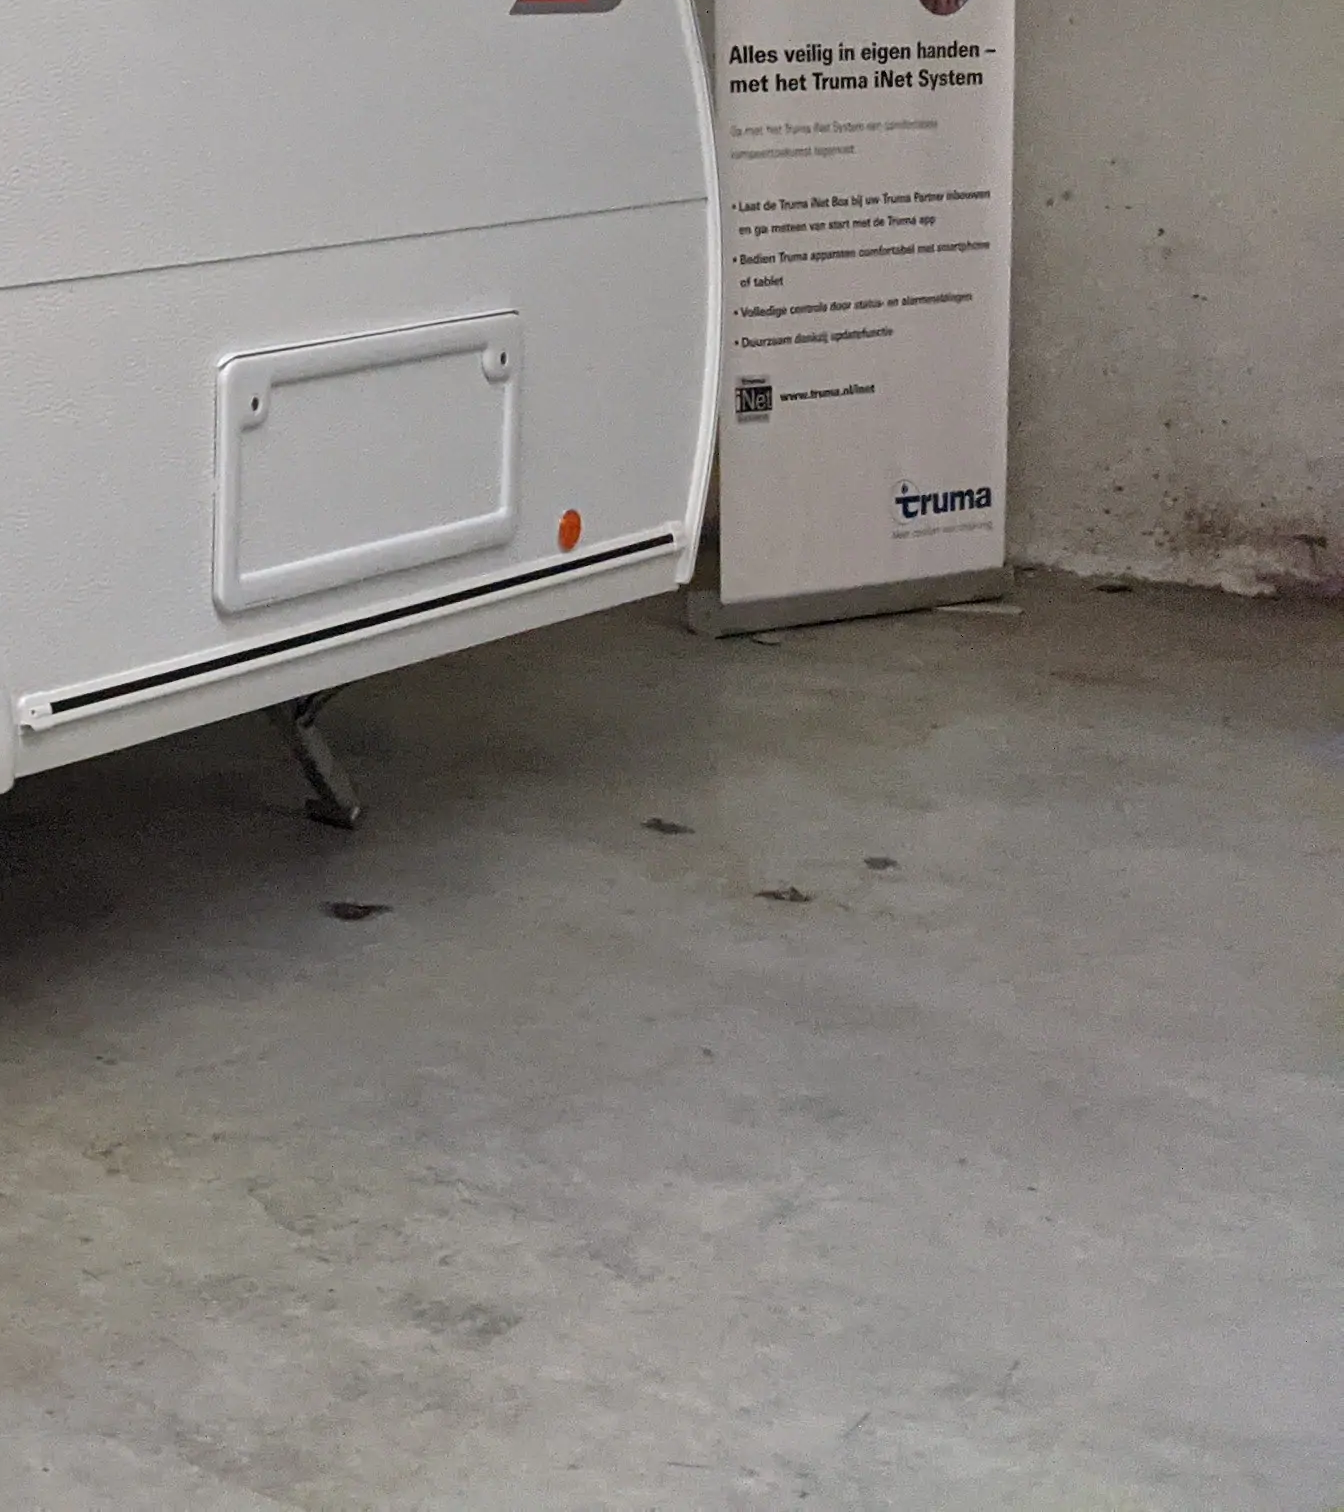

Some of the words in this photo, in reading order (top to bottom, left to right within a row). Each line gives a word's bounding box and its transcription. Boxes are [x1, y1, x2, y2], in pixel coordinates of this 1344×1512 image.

[729, 45, 778, 65] Alles
[784, 43, 833, 66] veilig
[838, 42, 855, 62] in
[860, 42, 911, 64] eigen
[916, 40, 980, 59] handen
[729, 75, 769, 93] met
[775, 73, 807, 92] het
[812, 72, 868, 90] Truma
[874, 70, 913, 88] iNet
[918, 69, 983, 90] System
[779, 198, 808, 211] Truma
[895, 486, 992, 519] truma
